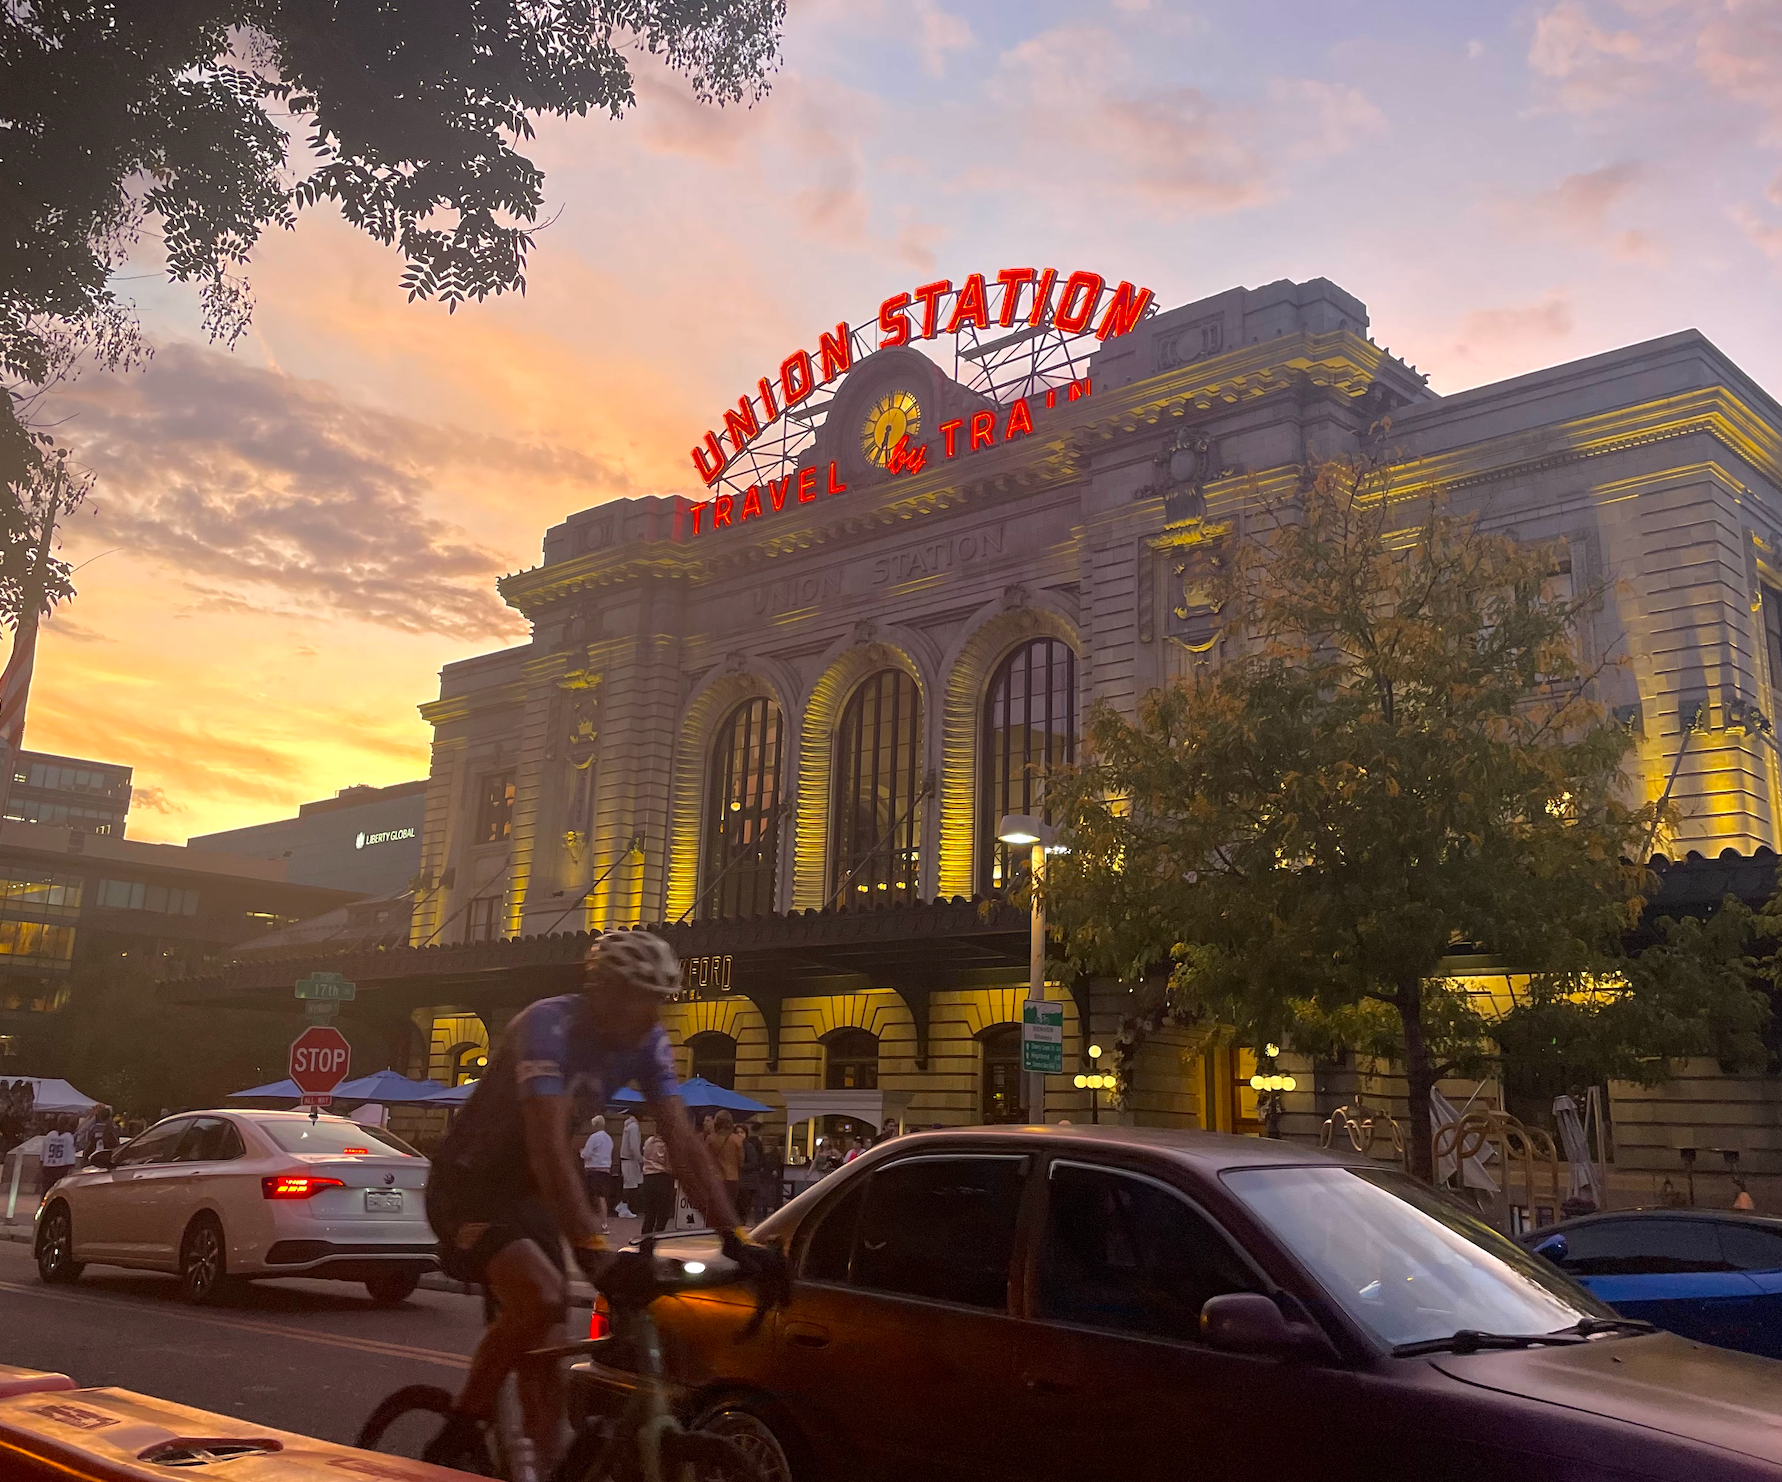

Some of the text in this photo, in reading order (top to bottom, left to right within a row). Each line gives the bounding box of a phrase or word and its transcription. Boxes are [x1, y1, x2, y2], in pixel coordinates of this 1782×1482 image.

[689, 268, 1156, 486] UNION STATION
[690, 377, 1091, 535] TRAVEL by TRAIN
[752, 526, 1005, 614] UNION STATION
[365, 827, 415, 845] LIBERTY GLOBAL
[315, 983, 339, 997] 17th
[295, 1047, 346, 1073] STOP
[303, 1096, 330, 1105] ALL WAY
[48, 1143, 64, 1159] 96
